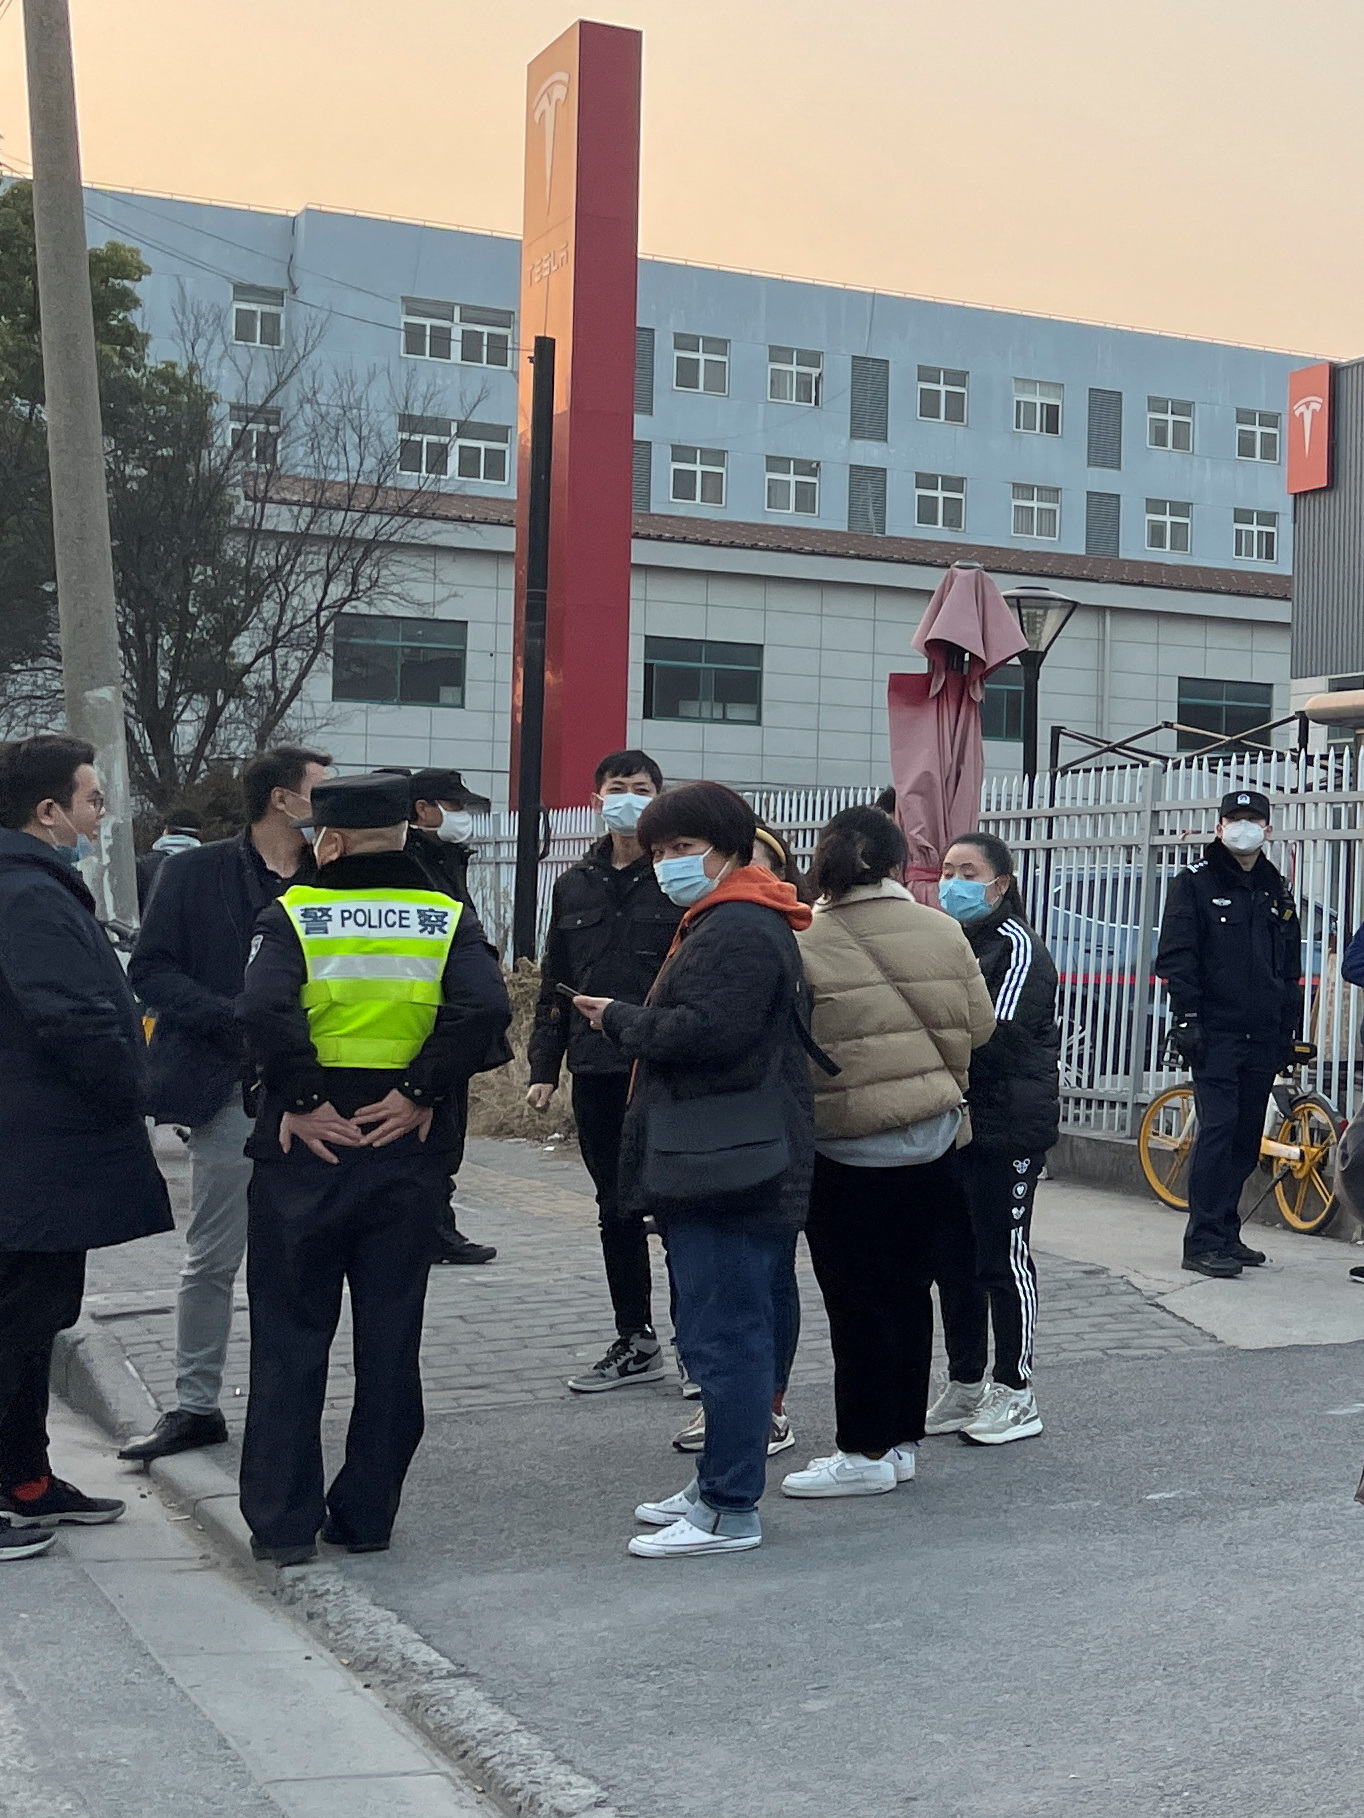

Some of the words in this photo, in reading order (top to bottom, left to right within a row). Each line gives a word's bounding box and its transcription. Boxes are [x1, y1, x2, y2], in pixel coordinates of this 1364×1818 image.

[299, 906, 333, 935] 警
[340, 908, 411, 929] POLICE
[416, 908, 449, 935] 察
